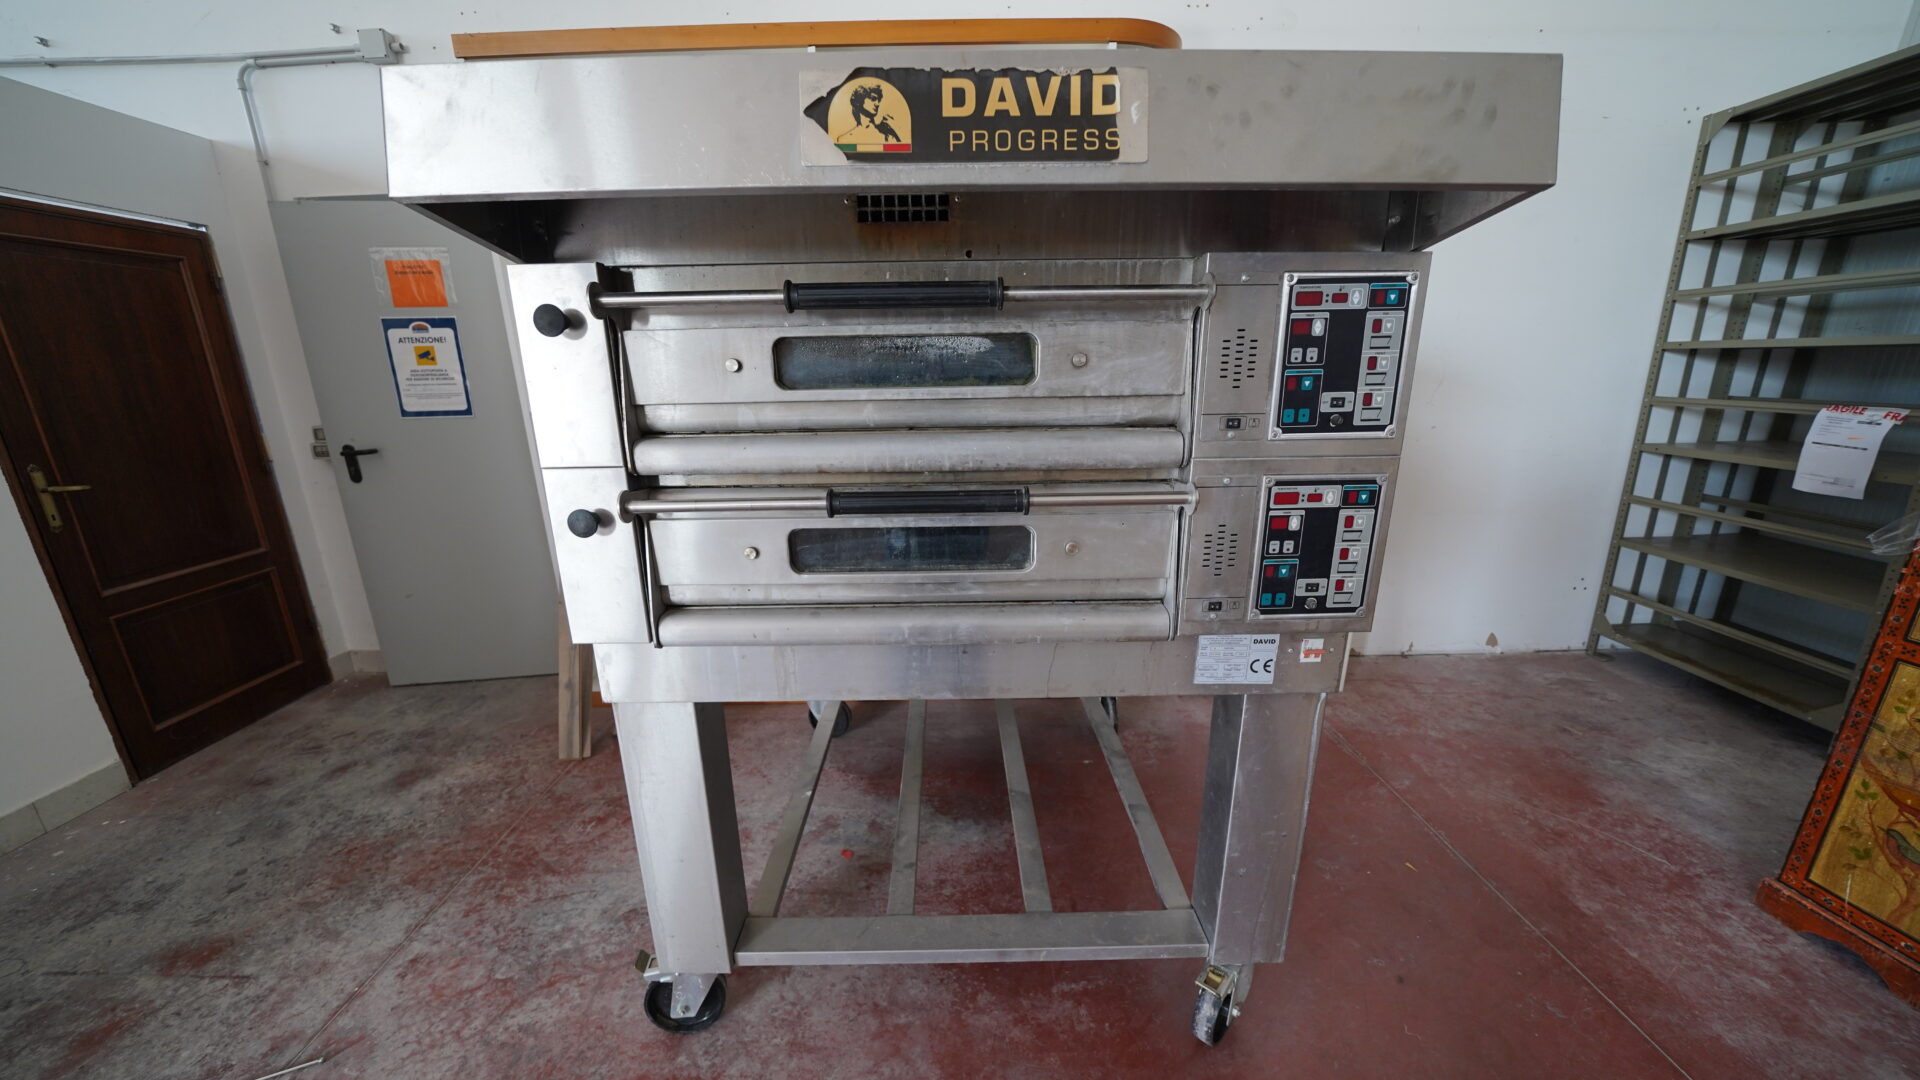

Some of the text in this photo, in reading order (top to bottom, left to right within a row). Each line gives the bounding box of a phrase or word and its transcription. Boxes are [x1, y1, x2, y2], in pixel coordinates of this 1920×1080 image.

[942, 74, 1121, 118] DAVID
[949, 128, 1121, 152] PROGRESS
[398, 336, 447, 344] ATTENZIONE!
